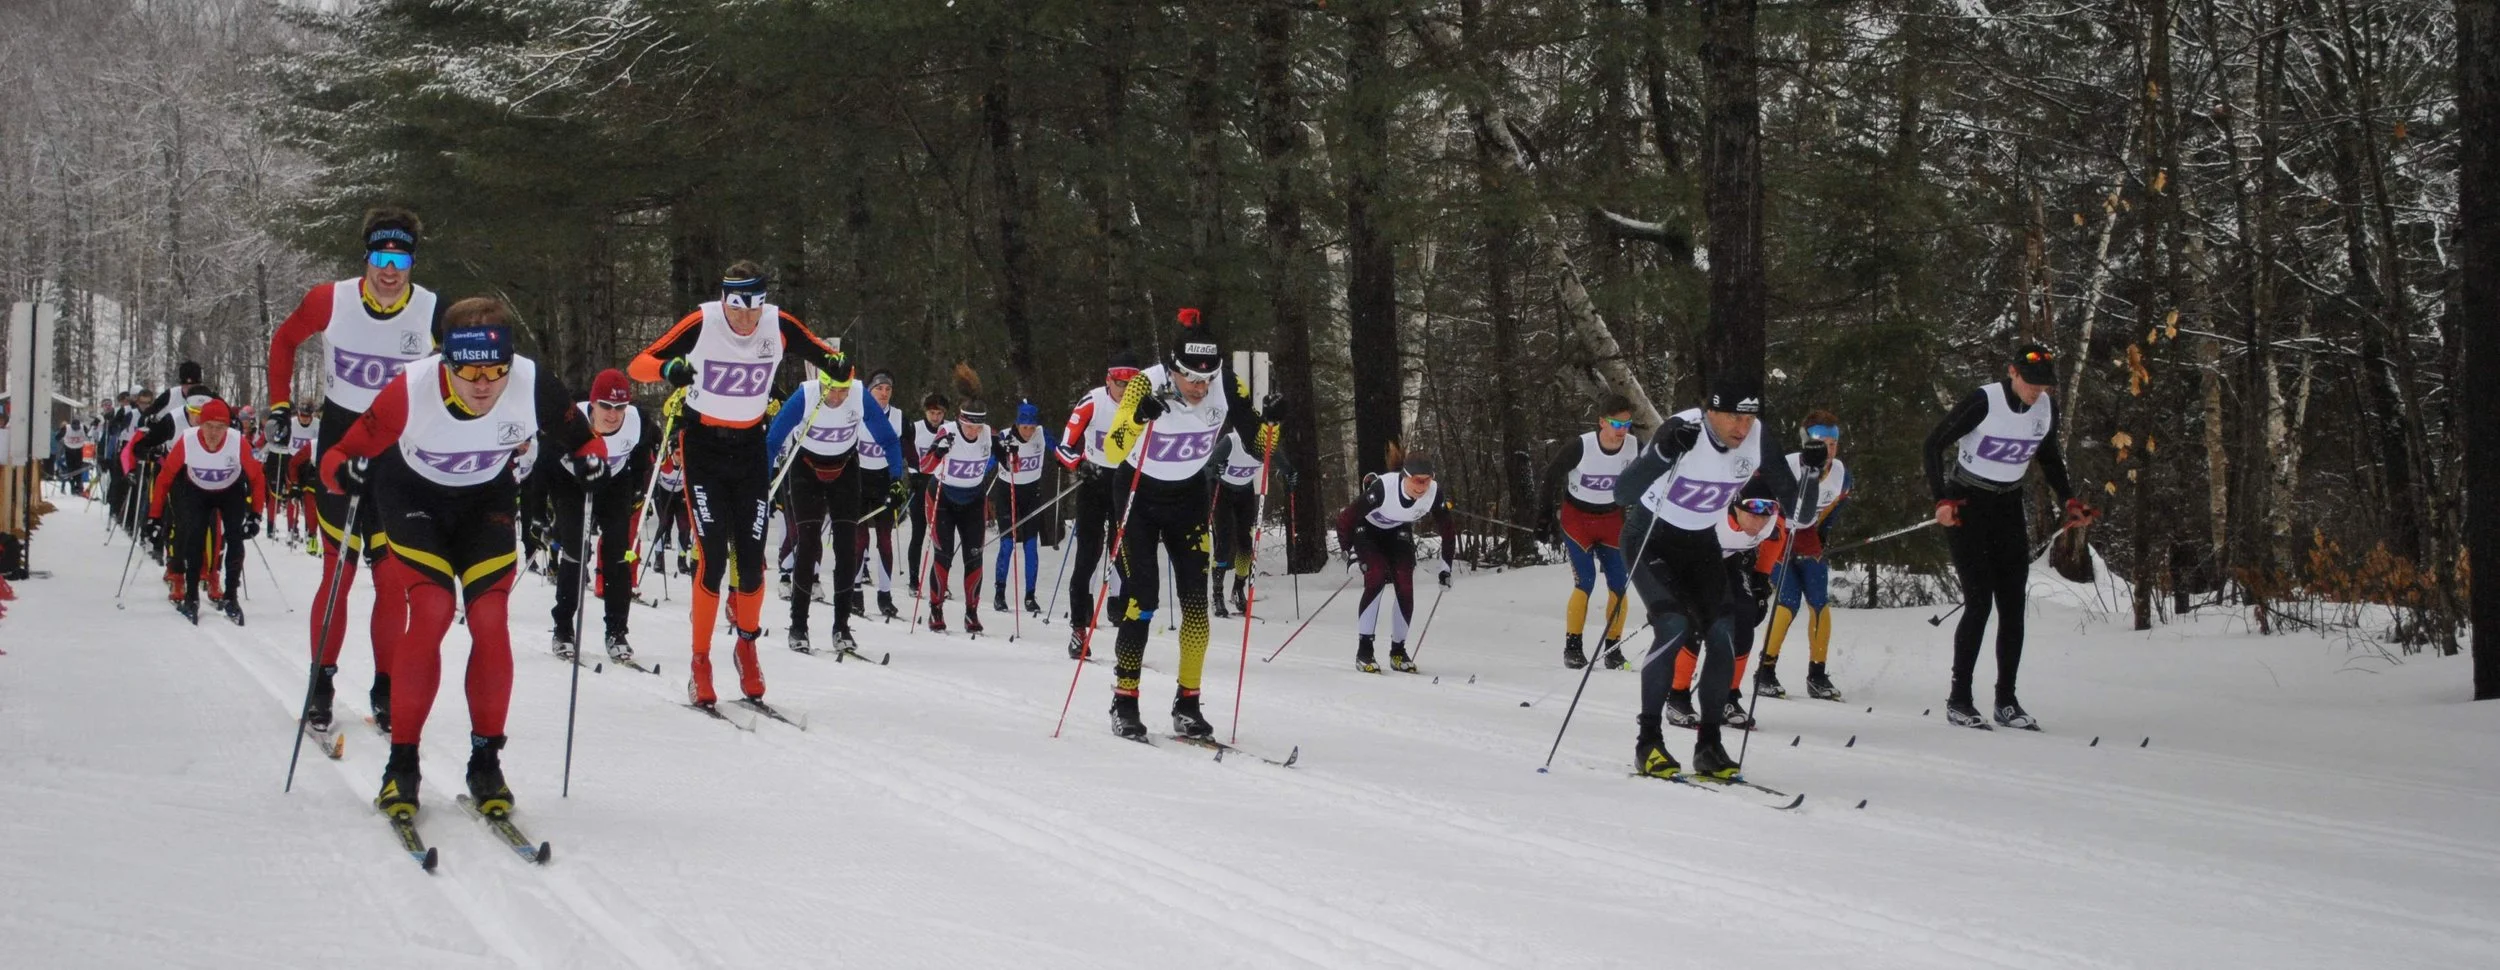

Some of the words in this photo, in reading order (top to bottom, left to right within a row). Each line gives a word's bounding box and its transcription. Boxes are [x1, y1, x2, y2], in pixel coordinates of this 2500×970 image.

[453, 348, 489, 360] BYÅSEN
[491, 350, 499, 359] IL
[709, 366, 767, 393] 729
[863, 443, 886, 457] 70
[1157, 434, 1214, 459] 763
[1986, 440, 2038, 461] 725
[952, 461, 985, 476] 743
[1020, 456, 1038, 470] 20
[1233, 468, 1258, 477] 76
[1678, 483, 1738, 509] 721
